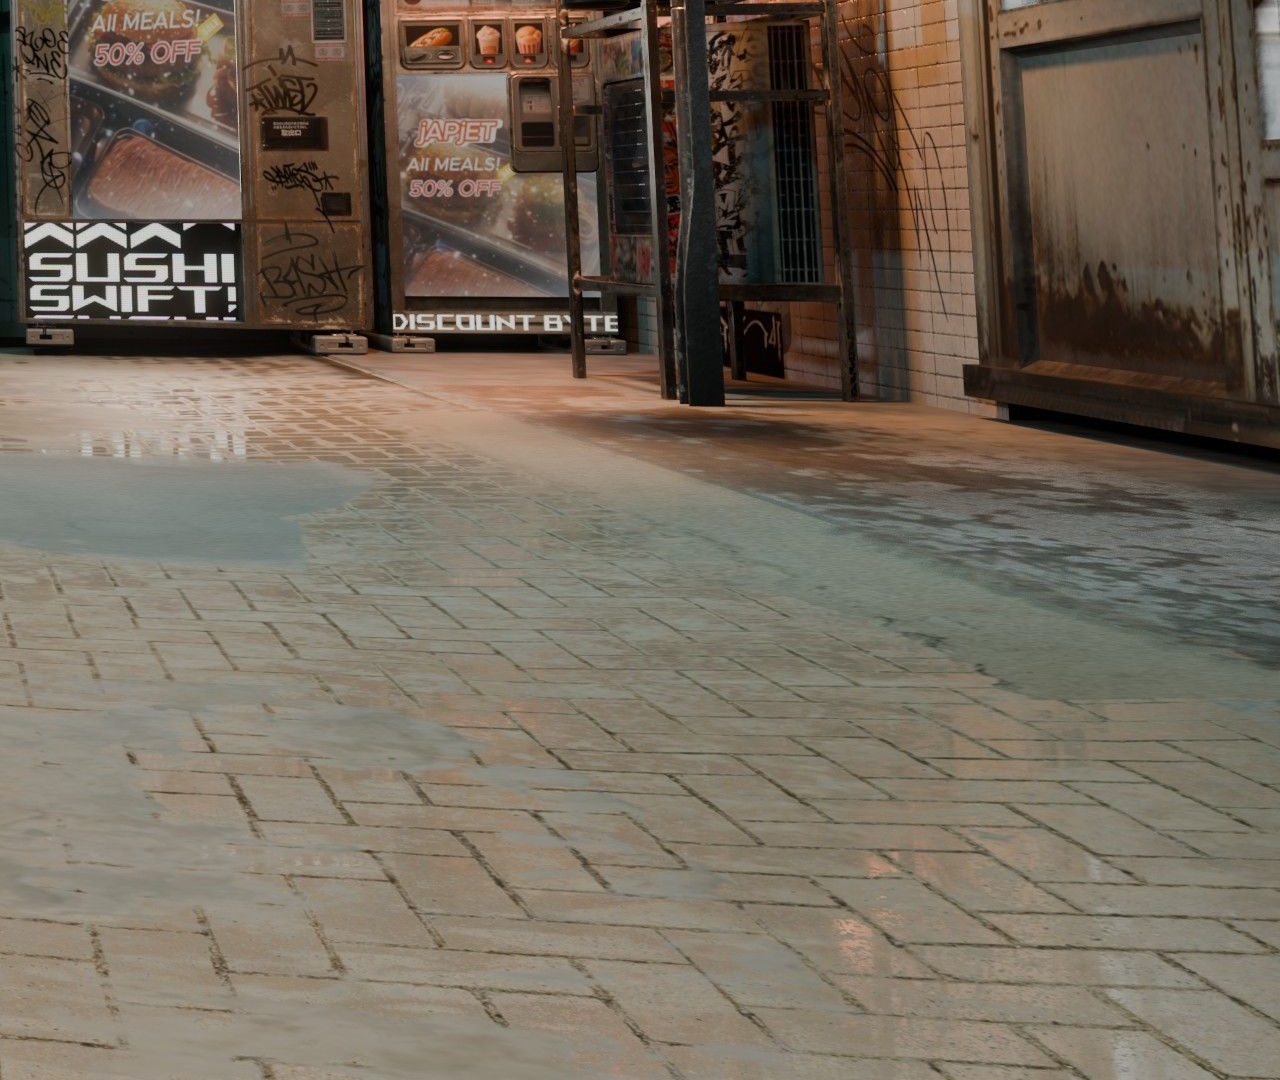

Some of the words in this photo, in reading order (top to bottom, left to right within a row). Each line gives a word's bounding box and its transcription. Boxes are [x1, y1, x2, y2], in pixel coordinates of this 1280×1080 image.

[122, 9, 201, 32] MEALS!
[93, 41, 145, 67] 50%
[150, 38, 204, 65] OFF
[433, 156, 502, 172] MEALS!
[408, 179, 454, 198] 50%
[458, 179, 503, 198] OFF
[28, 252, 236, 283] SUSHI
[29, 284, 237, 314] SWIFT!
[392, 313, 536, 332] DISCOUNT
